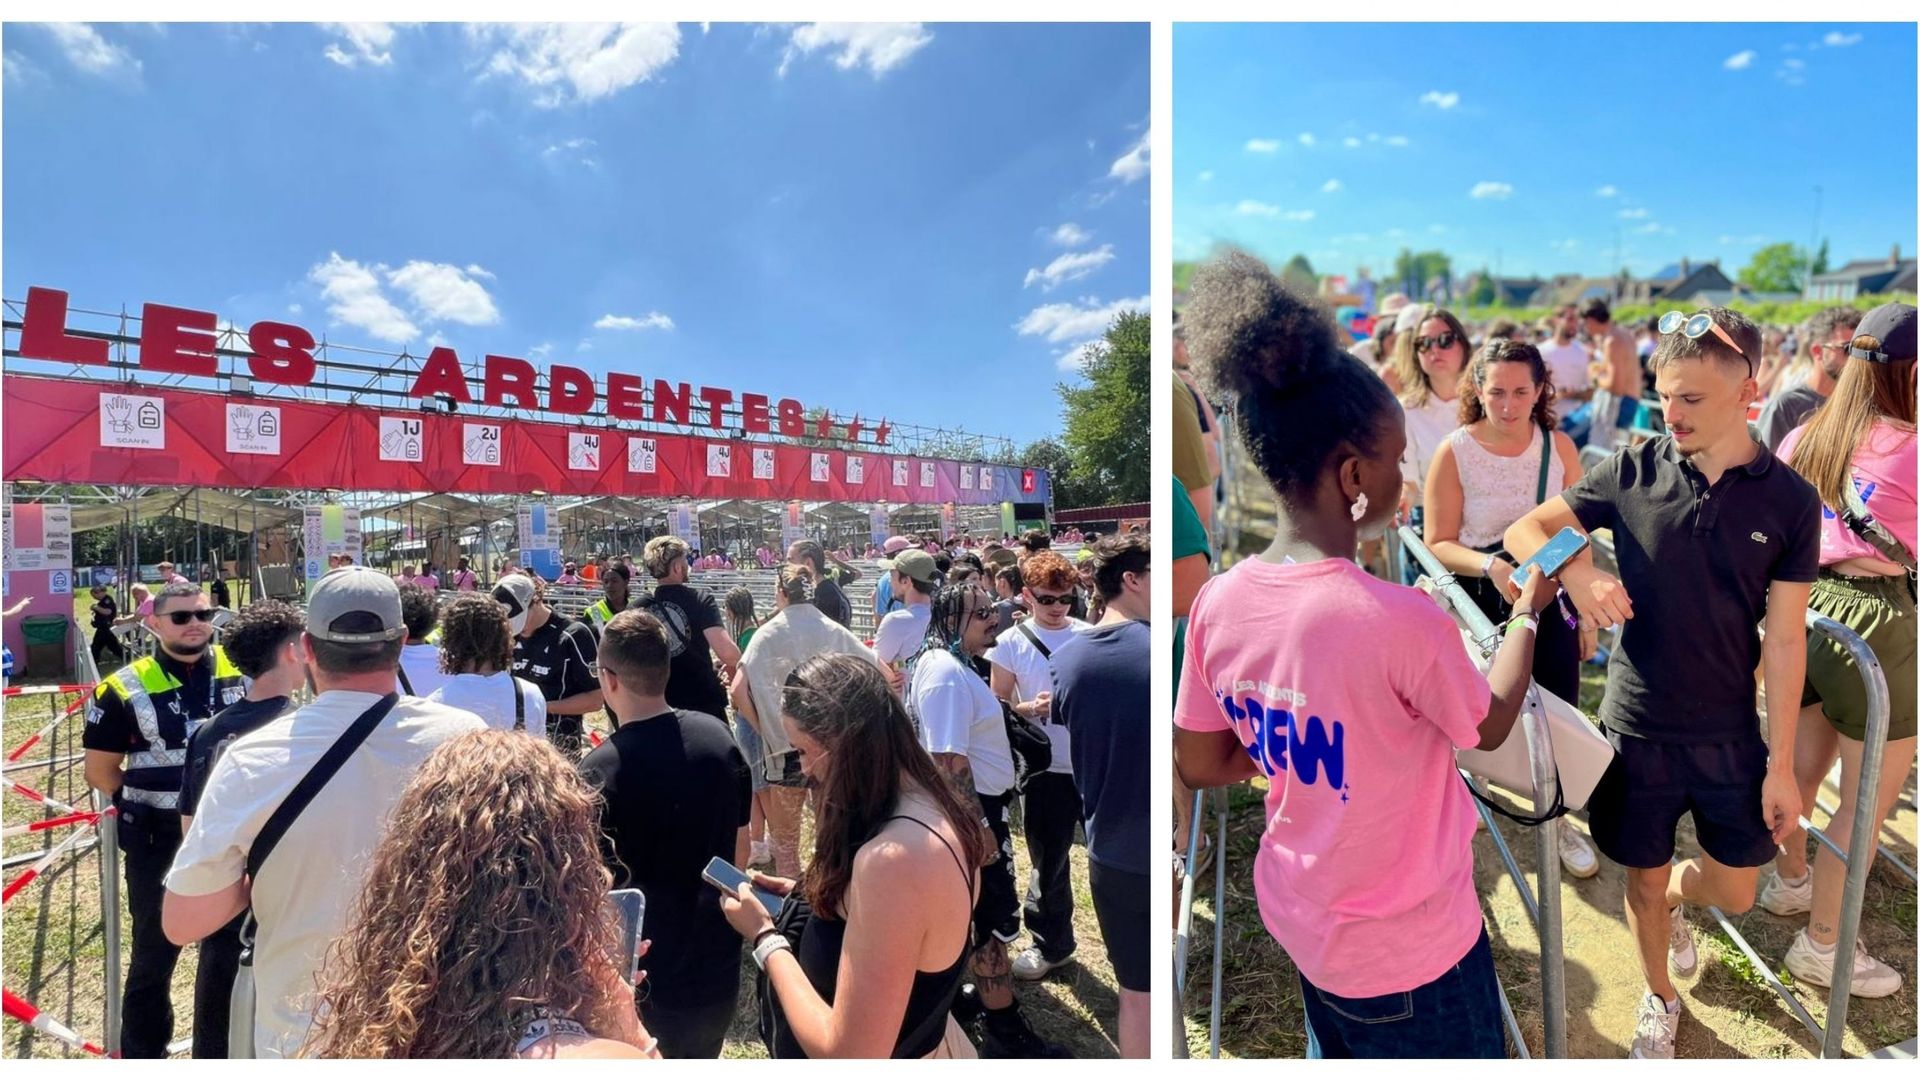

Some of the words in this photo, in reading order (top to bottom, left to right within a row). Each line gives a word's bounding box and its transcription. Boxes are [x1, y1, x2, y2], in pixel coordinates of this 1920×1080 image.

[20, 286, 316, 385] LES
[409, 346, 805, 437] ARDENTES
[402, 420, 420, 436] 1J
[481, 427, 498, 440] 2J
[585, 435, 599, 448] 4J
[642, 440, 655, 452] 4J
[719, 446, 730, 458] 4J
[1224, 696, 1344, 790] CREW
